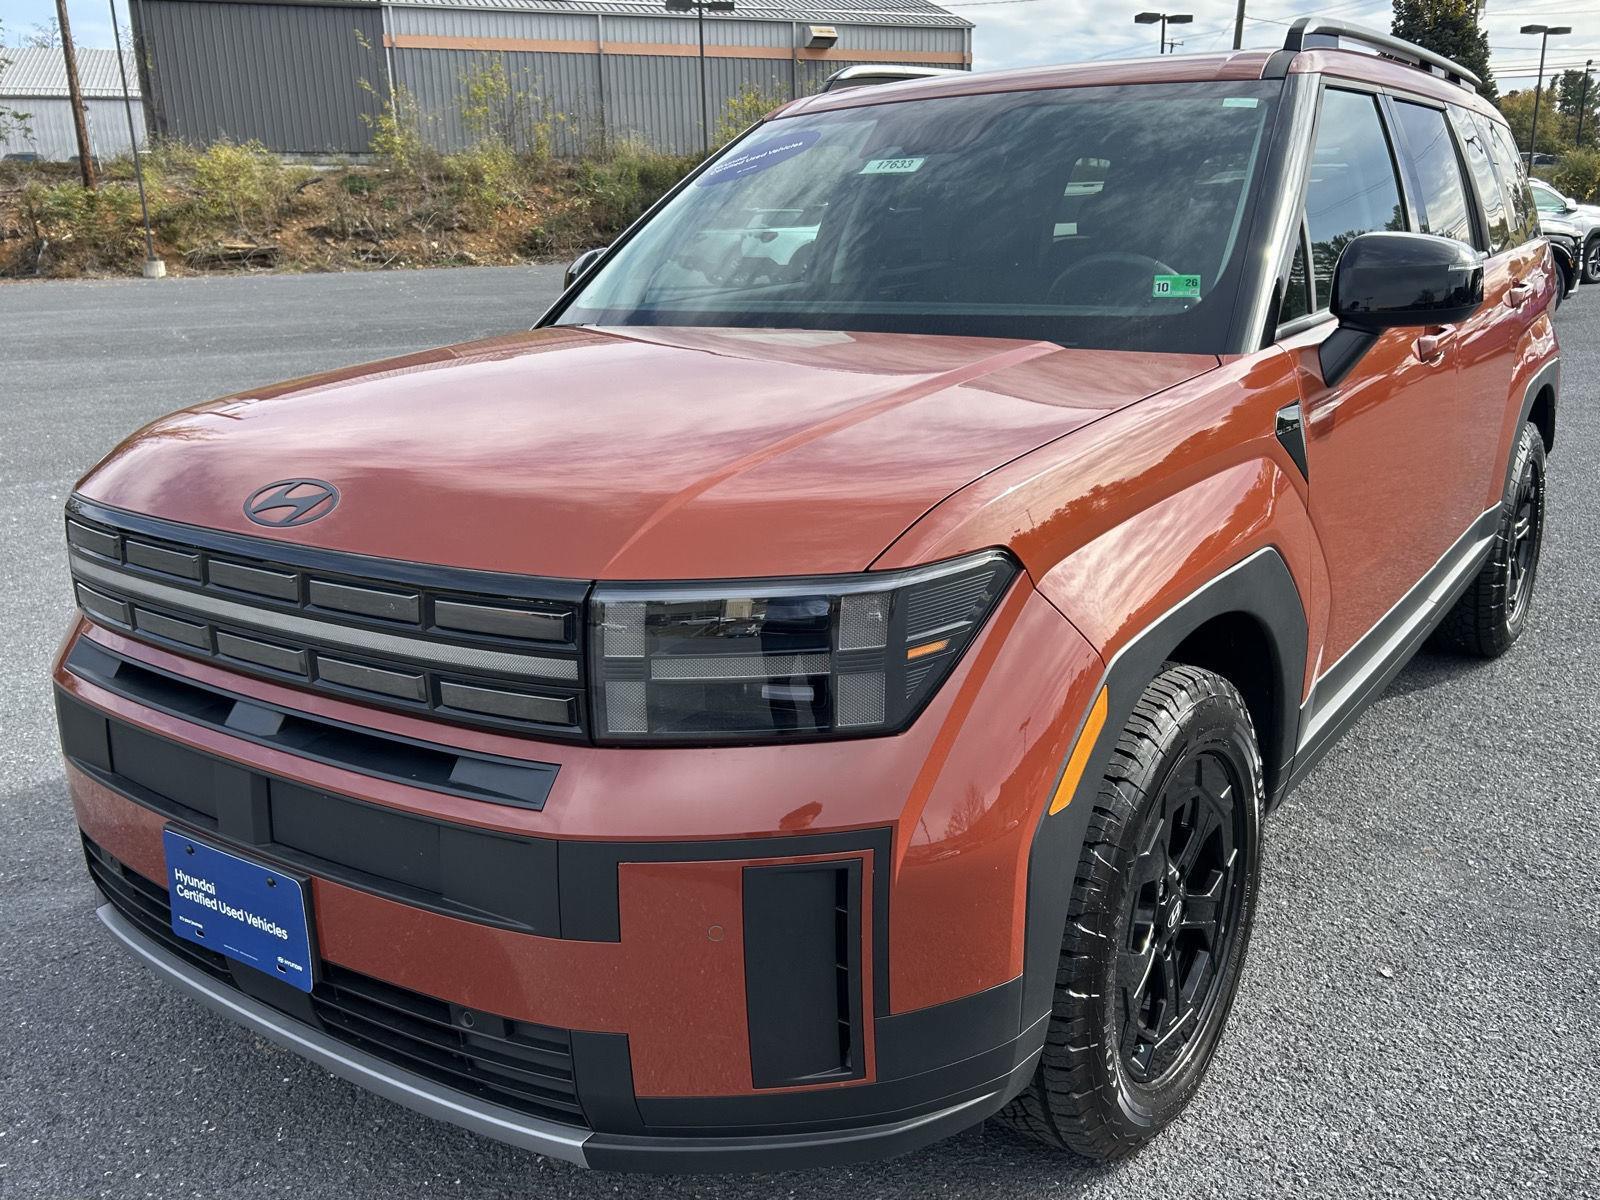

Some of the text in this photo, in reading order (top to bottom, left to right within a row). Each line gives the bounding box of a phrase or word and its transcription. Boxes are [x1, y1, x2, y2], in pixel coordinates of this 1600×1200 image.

[876, 159, 914, 170] 17633
[1155, 282, 1169, 292] 10
[1185, 278, 1198, 287] 26
[174, 868, 216, 895] Hyundai
[176, 884, 289, 940] Certified Used Vehicles
